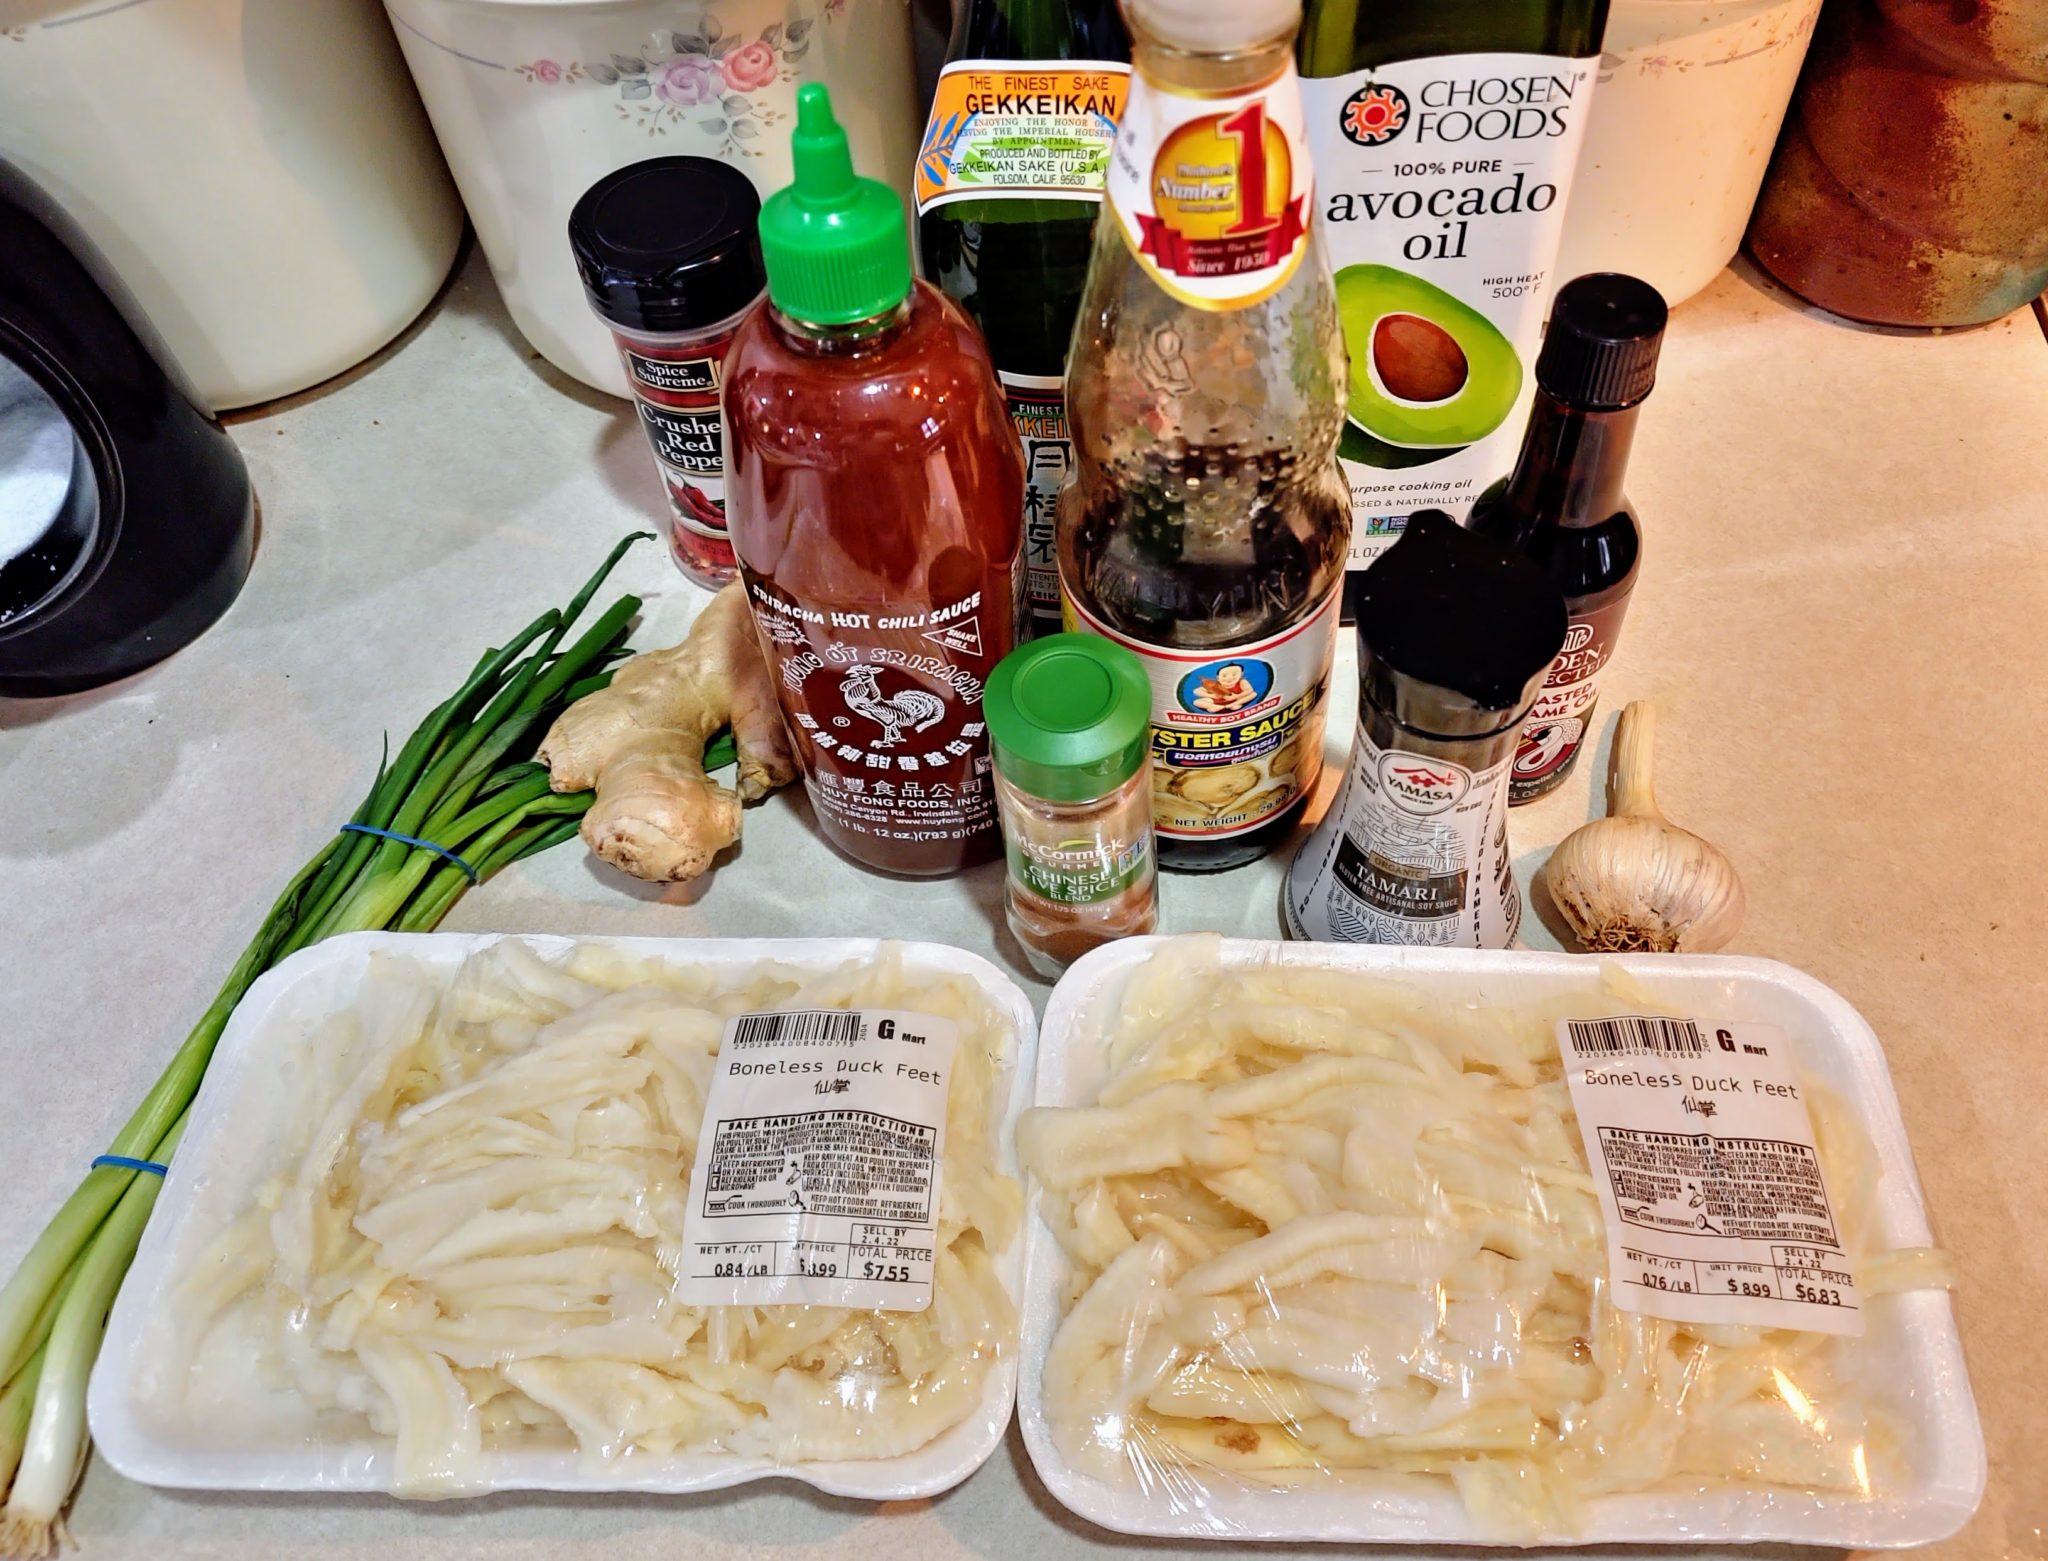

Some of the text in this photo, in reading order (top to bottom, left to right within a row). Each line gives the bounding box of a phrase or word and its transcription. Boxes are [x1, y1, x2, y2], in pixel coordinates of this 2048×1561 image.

[968, 76, 1109, 90] THE FINEST SAKE
[1420, 73, 1579, 108] CHOSEN
[966, 94, 1116, 116] GEKKEIKAN
[974, 118, 1019, 127] ENJOYING
[1027, 118, 1046, 126] THE
[1055, 118, 1088, 127] HONOR
[994, 127, 1069, 136] THE IMPERIAL
[1415, 105, 1570, 144] FOODS
[992, 137, 1083, 146] BY APPOINTMENT
[980, 149, 1100, 160] PRODUCED AND BOTTLED BY
[950, 161, 1014, 175] GEKKEIKAN
[1018, 161, 1056, 172] SAKE
[1158, 176, 1234, 201] Number
[1217, 98, 1282, 238] 1
[1393, 160, 1503, 177] 100% PURE
[993, 175, 1030, 185] FOLSOM,
[1060, 175, 1086, 186] 95630
[1326, 172, 1558, 223] avocado
[1402, 221, 1468, 261] oil
[1482, 271, 1545, 286] HIGH HEAT
[637, 367, 705, 387] Supreme
[645, 361, 688, 376] Spice
[641, 403, 721, 435] Crushe
[1019, 404, 1060, 416] FINEST
[665, 430, 716, 451] Red
[656, 439, 722, 471] Peppe
[1350, 479, 1472, 494] urpose cooking oil
[1396, 496, 1462, 506] NATURALLY
[753, 584, 981, 629] SRIRACHA HOT CHILI SAUCE
[944, 637, 968, 650] WELL
[946, 628, 978, 643] SHAKE
[1552, 641, 1604, 673] DEN
[869, 648, 984, 705] SRIRACHA
[1544, 654, 1608, 685] ECTED
[1535, 682, 1593, 706] ASTED
[1151, 686, 1316, 748] YSTER SAUCE
[1172, 698, 1277, 723] HEALTHY BOY BRAND
[1530, 704, 1568, 719] AME
[821, 785, 850, 799] HUY
[853, 795, 894, 807] FONG
[1387, 774, 1454, 800] YAMASA
[1522, 789, 1540, 798] OZ
[850, 804, 888, 815] Canyon
[965, 806, 982, 814] CA
[1175, 814, 1248, 827] NET WEIGHT
[874, 829, 890, 838] 12
[1029, 865, 1111, 886] CHINESE
[1374, 857, 1421, 879] ORGANIC
[1023, 870, 1120, 896] FIVE SPICE
[1355, 862, 1438, 901] TAMARI
[1050, 892, 1092, 902] BLEND
[1376, 892, 1415, 909] ARTISANAL
[1418, 901, 1433, 910] SOY
[1435, 898, 1458, 909] SAUCE
[1473, 890, 1481, 949] AMERIC
[877, 1019, 927, 1045] G Mart
[1715, 1029, 1769, 1056] G Mart
[729, 1059, 942, 1086] Boneless Duck Feet
[1585, 1069, 1800, 1100] Boneless Duck Feet
[728, 1120, 758, 1131] SAFE
[764, 1112, 825, 1129] HANDLING
[832, 1112, 925, 1137] INSTRUCTIONS
[1610, 1129, 1807, 1157] SAFE HANDLING INSTRUCTIONS
[861, 1236, 899, 1246] 2.4.22
[863, 1226, 907, 1237] SELL BY
[700, 1245, 762, 1255] NET WT./CT
[851, 1246, 932, 1262] TOTAL PRICE
[1626, 1251, 1643, 1262] NET
[1783, 1248, 1826, 1260] SELL BY
[714, 1262, 743, 1277] 0.84
[864, 1261, 910, 1282] $7.55
[1710, 1263, 1763, 1274] UNIT PRICE
[1778, 1267, 1854, 1287] TOTAL PRICE
[1642, 1272, 1667, 1290] 0.76
[1727, 1278, 1771, 1298] $ 8.99
[1796, 1283, 1841, 1306] $6.83
